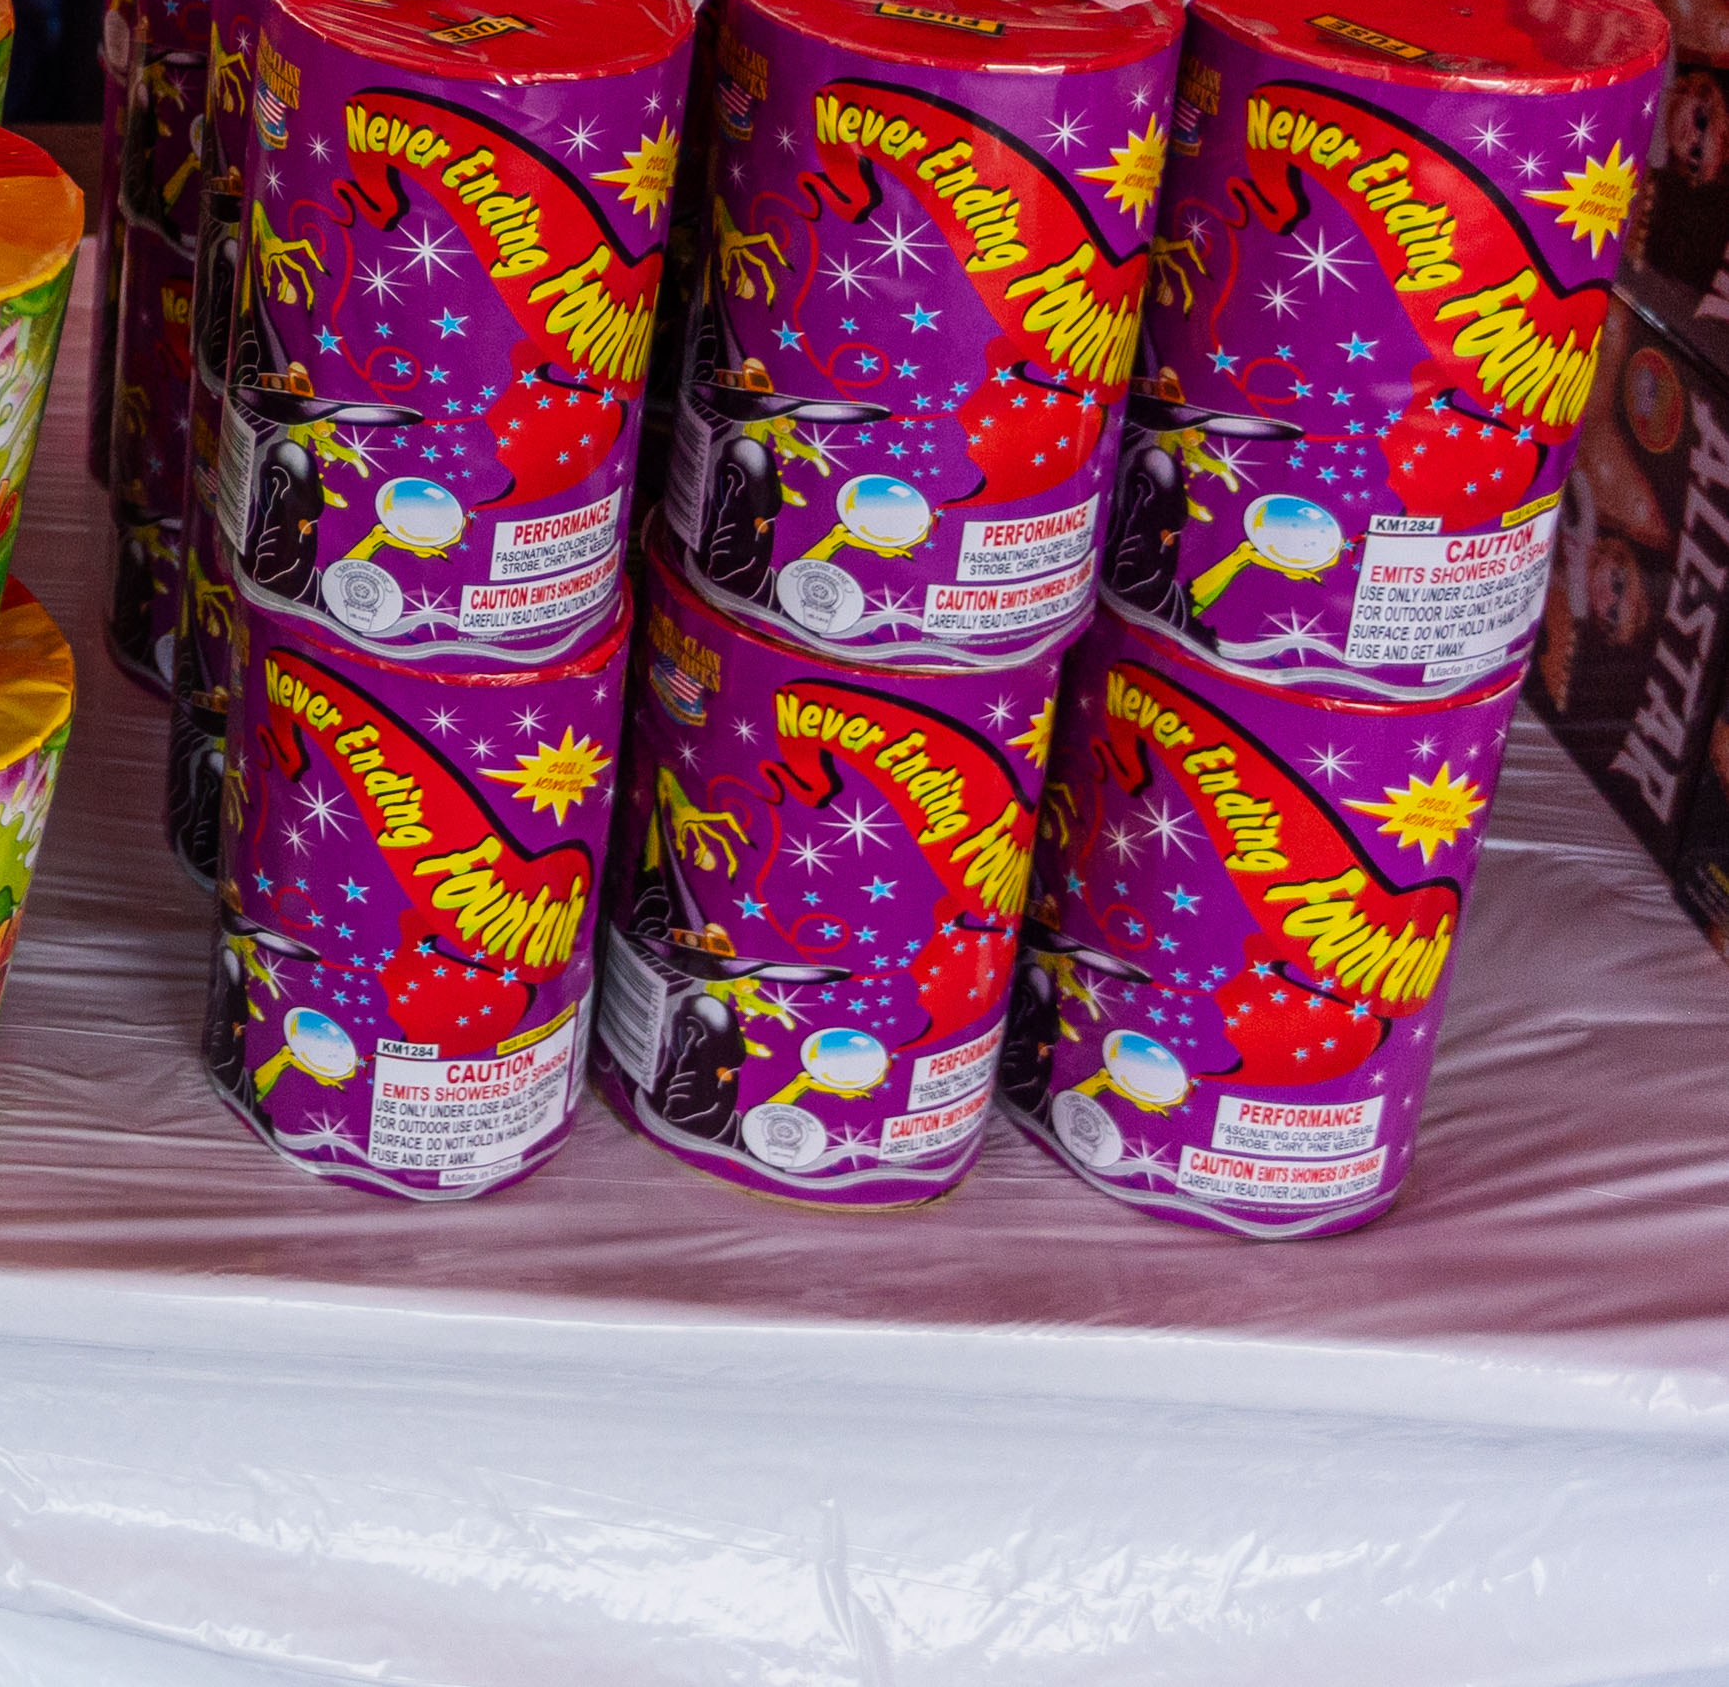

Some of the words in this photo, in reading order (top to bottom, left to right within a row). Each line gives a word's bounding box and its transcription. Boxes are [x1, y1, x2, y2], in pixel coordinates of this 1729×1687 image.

[345, 104, 452, 169] Never
[441, 146, 550, 280] Ending
[814, 95, 928, 162] Never
[916, 140, 1030, 274] Ending
[1246, 95, 1361, 170] Never
[1347, 151, 1463, 294] Ending
[513, 500, 611, 546] PERFORMANCE
[983, 505, 1088, 547] PERFORMANCE
[1375, 518, 1435, 532] KM1284
[495, 544, 556, 563] FASCINATING
[570, 547, 586, 562] PINE
[1446, 524, 1535, 564] CAUTION
[1370, 565, 1425, 584] EMITS
[1430, 556, 1505, 583] SHOWERS
[471, 586, 527, 610] CAUTION
[531, 582, 555, 604] EMITS
[936, 589, 998, 611] CAUTION
[1356, 605, 1381, 621] FOR
[1385, 606, 1446, 622] OUTDOOR
[1349, 643, 1380, 659] FUSE
[1383, 644, 1408, 660] AND
[1411, 645, 1433, 660] GET
[1428, 665, 1462, 677] Made
[774, 691, 886, 754] Never
[873, 729, 971, 846] Ending
[264, 657, 343, 732] Never
[335, 720, 434, 850] Ending
[412, 834, 587, 968] Fountain
[1106, 668, 1197, 752] Never
[1182, 742, 1289, 873] Ending
[1262, 866, 1454, 1003] Fountain
[382, 1042, 433, 1056] KM1284
[447, 1049, 535, 1084] CAUTION
[383, 1083, 431, 1101] EMITS
[435, 1082, 510, 1101] SHOWERS
[1239, 1103, 1364, 1127] PERFORMANCE
[1218, 1123, 1289, 1141] FASCINATING
[371, 1147, 398, 1163] FUSE
[401, 1150, 423, 1164] AND
[425, 1152, 445, 1166] GET
[1307, 1142, 1332, 1152] PINE
[1190, 1153, 1254, 1180] CAUTION
